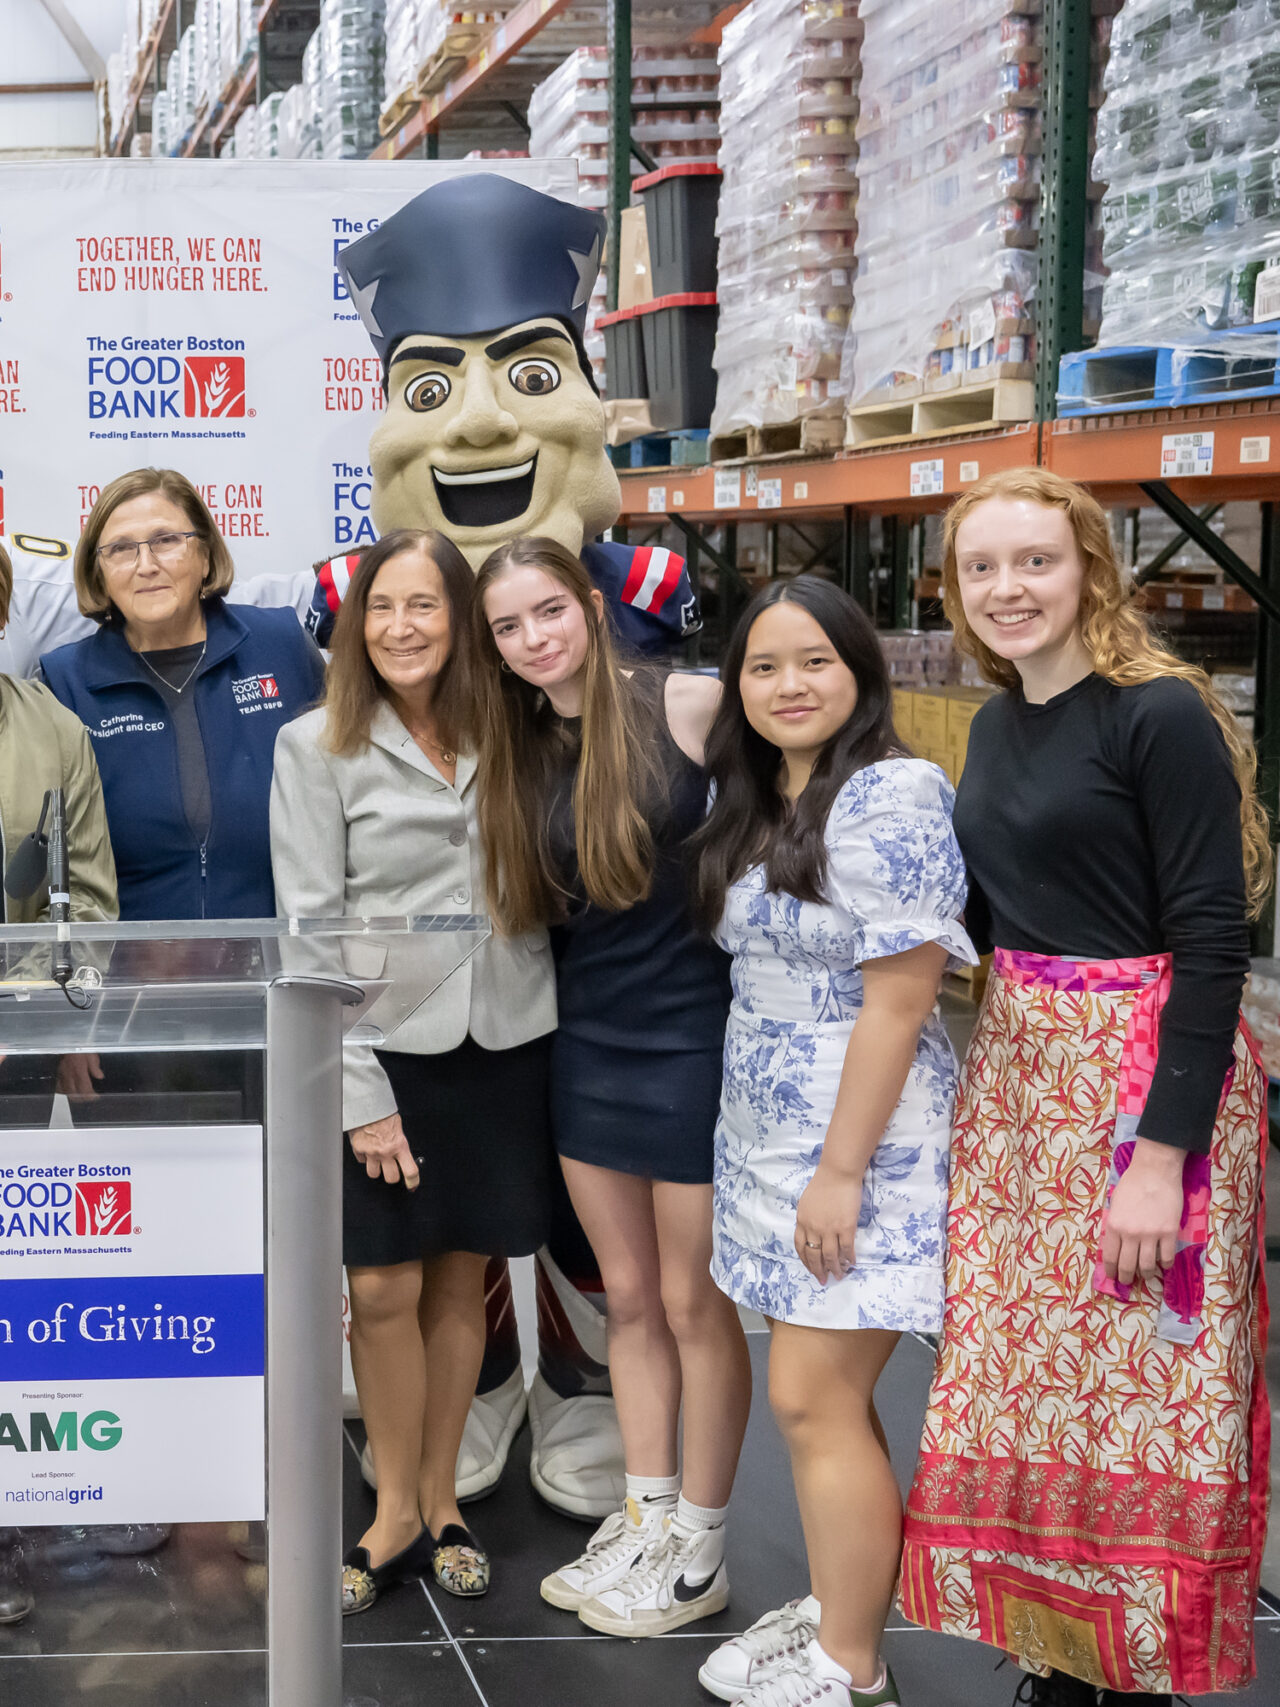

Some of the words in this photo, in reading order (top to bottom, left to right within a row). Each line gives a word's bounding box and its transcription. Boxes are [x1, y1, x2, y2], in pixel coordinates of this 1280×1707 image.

[333, 218, 363, 232] The
[77, 237, 179, 265] TOGETHER,
[188, 238, 216, 262] WE
[224, 238, 260, 262] CAN
[78, 267, 116, 291] END
[124, 266, 204, 291] HUNGER
[213, 267, 267, 291] HERE.
[87, 337, 117, 351] The
[121, 336, 182, 351] Greater
[187, 336, 245, 350] Boston
[89, 357, 180, 385] FOOD
[323, 358, 382, 382] TOGET
[89, 390, 179, 418] BANK
[325, 387, 363, 411] END
[89, 432, 128, 440] Feeding
[333, 464, 363, 477] The
[225, 484, 262, 509] CAN
[232, 681, 259, 694] FOOD
[235, 690, 262, 704] BANK
[239, 704, 262, 715] TEAM
[100, 713, 144, 728] Catherine
[126, 723, 143, 732] and
[144, 722, 164, 731] CEO
[18, 1166, 74, 1178] Greater
[78, 1164, 131, 1176] Boston
[28, 1303, 73, 1343] of
[79, 1304, 215, 1353] Giving
[6, 1485, 103, 1504] nationalgrid
